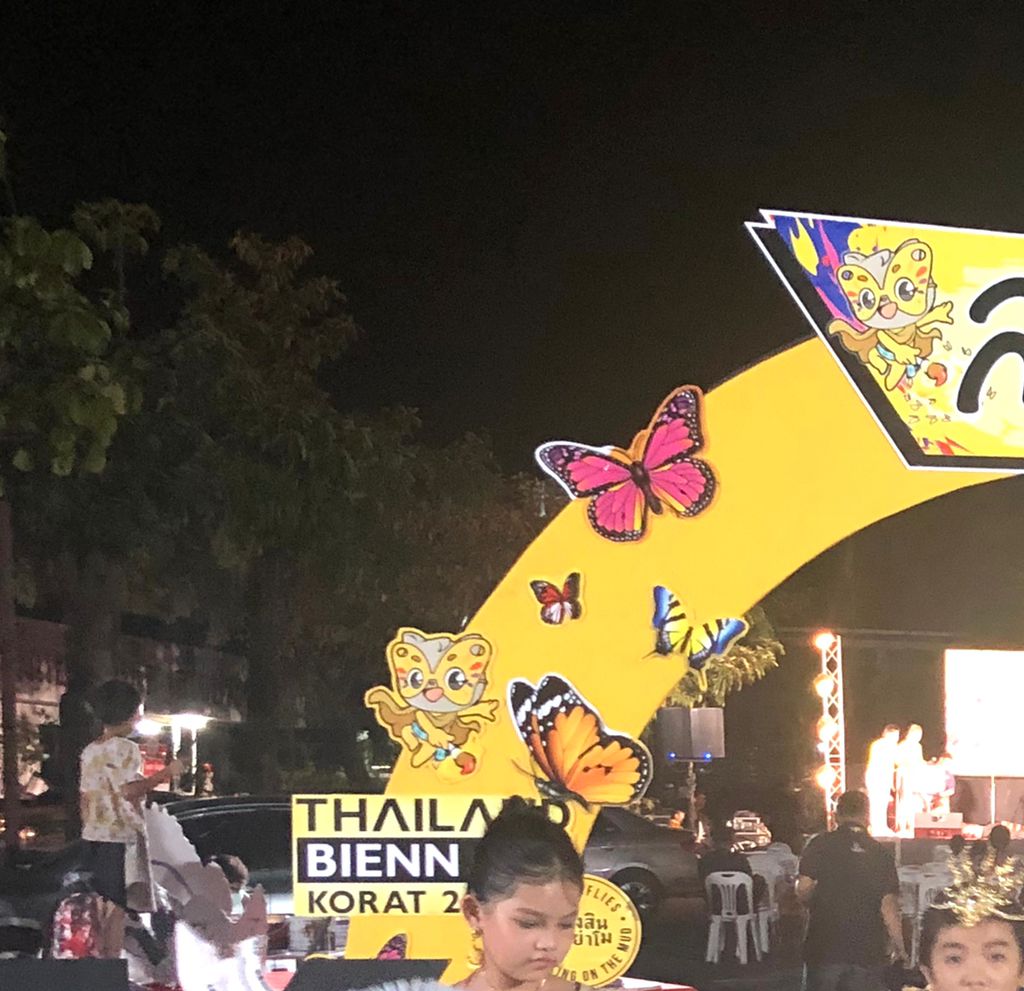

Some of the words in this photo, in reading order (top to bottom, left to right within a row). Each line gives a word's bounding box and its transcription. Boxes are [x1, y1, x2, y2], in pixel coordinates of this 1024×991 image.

[296, 799, 569, 832] THAILAD
[307, 843, 459, 878] BIENN
[308, 890, 427, 914] KORAT
[586, 885, 621, 912] FLIES
[600, 953, 623, 974] THE
[616, 928, 632, 952] MUD
